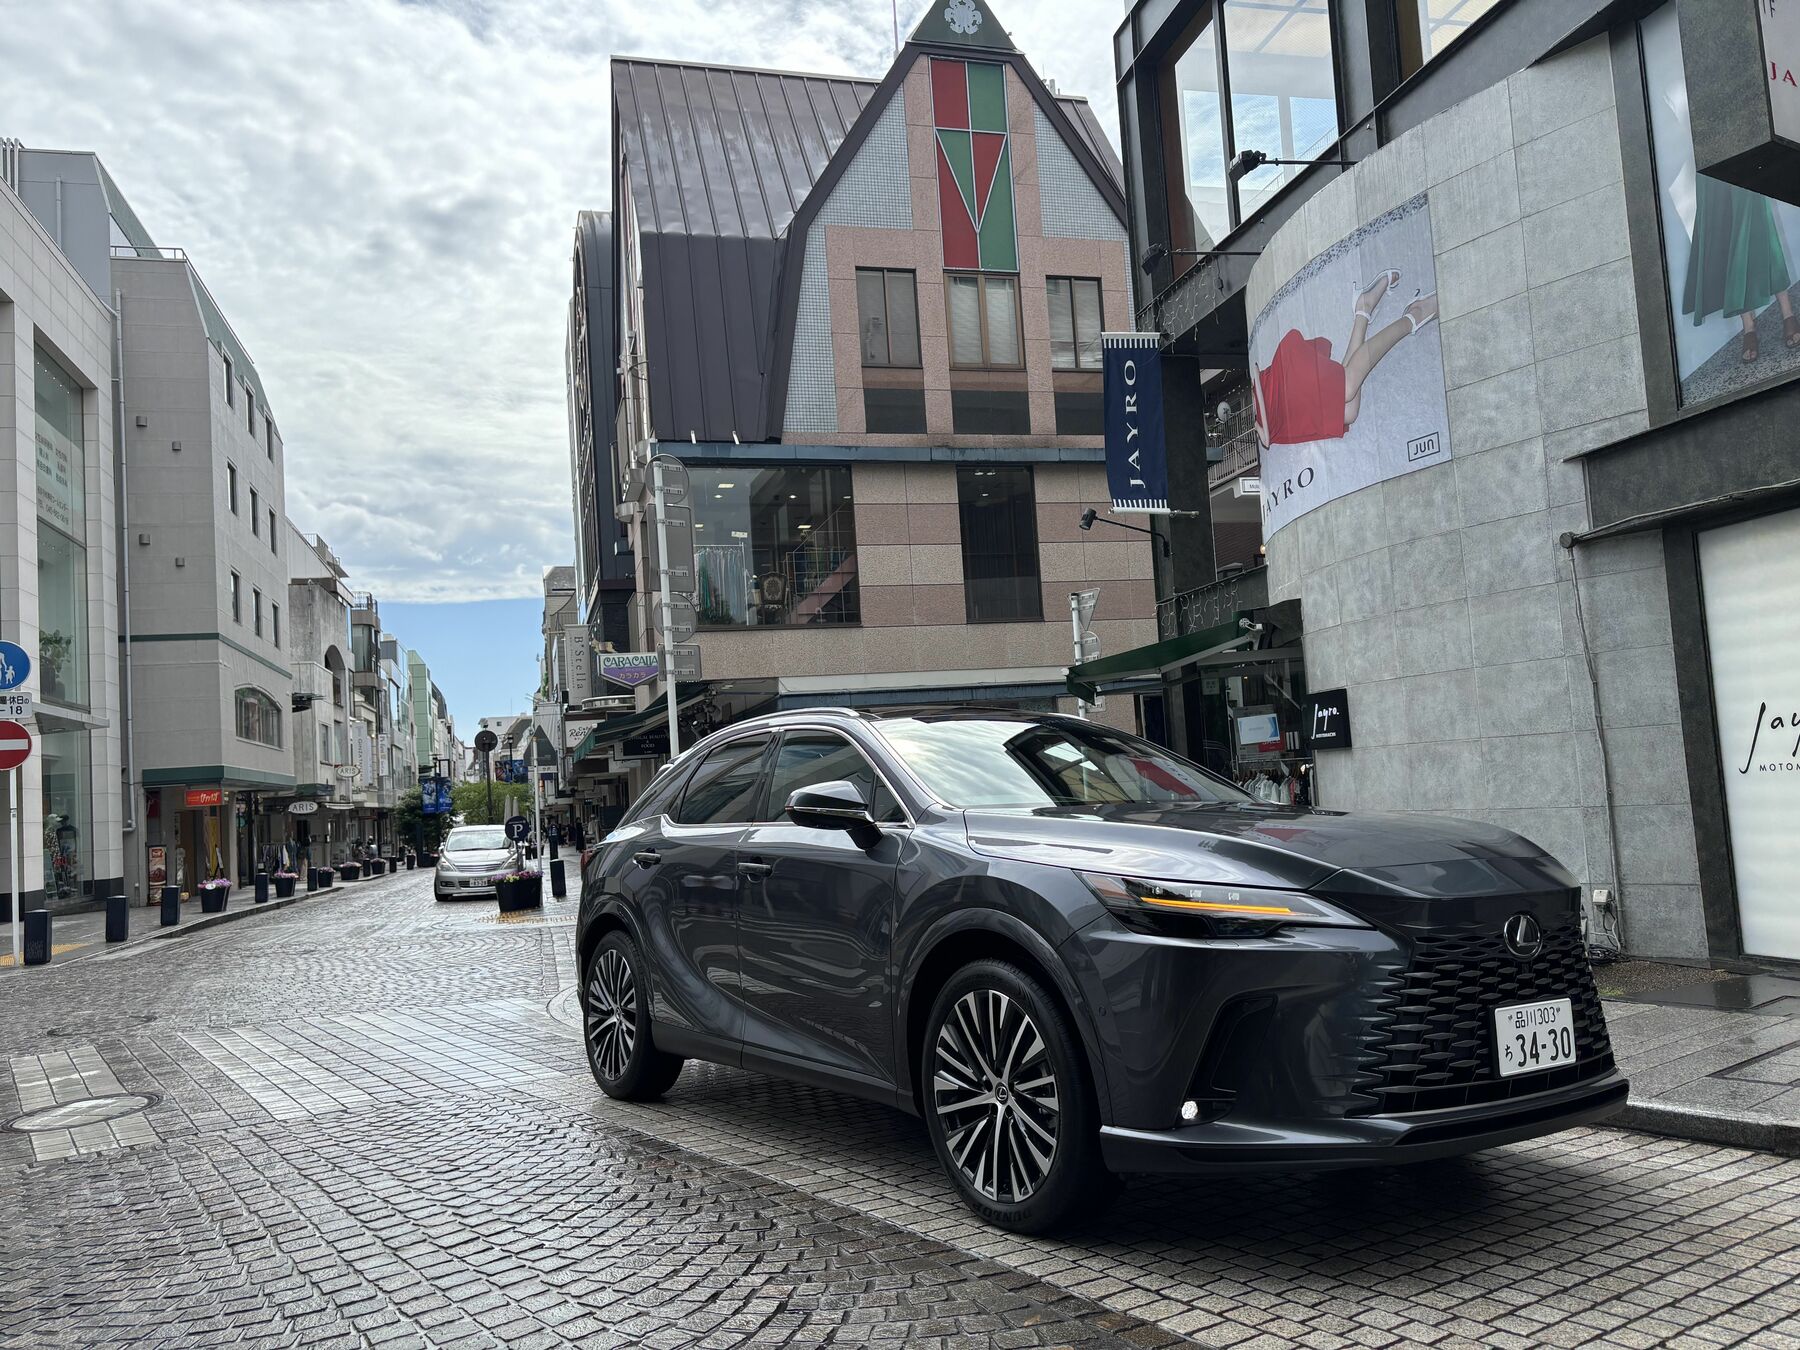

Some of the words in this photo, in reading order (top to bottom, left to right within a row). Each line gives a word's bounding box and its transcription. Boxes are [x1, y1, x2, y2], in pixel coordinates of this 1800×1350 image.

[1124, 360, 1146, 489] JAYRO
[340, 767, 357, 775] ARIS
[292, 802, 315, 812] ARIS
[512, 823, 524, 839] P
[1515, 1026, 1572, 1068] 34-30
